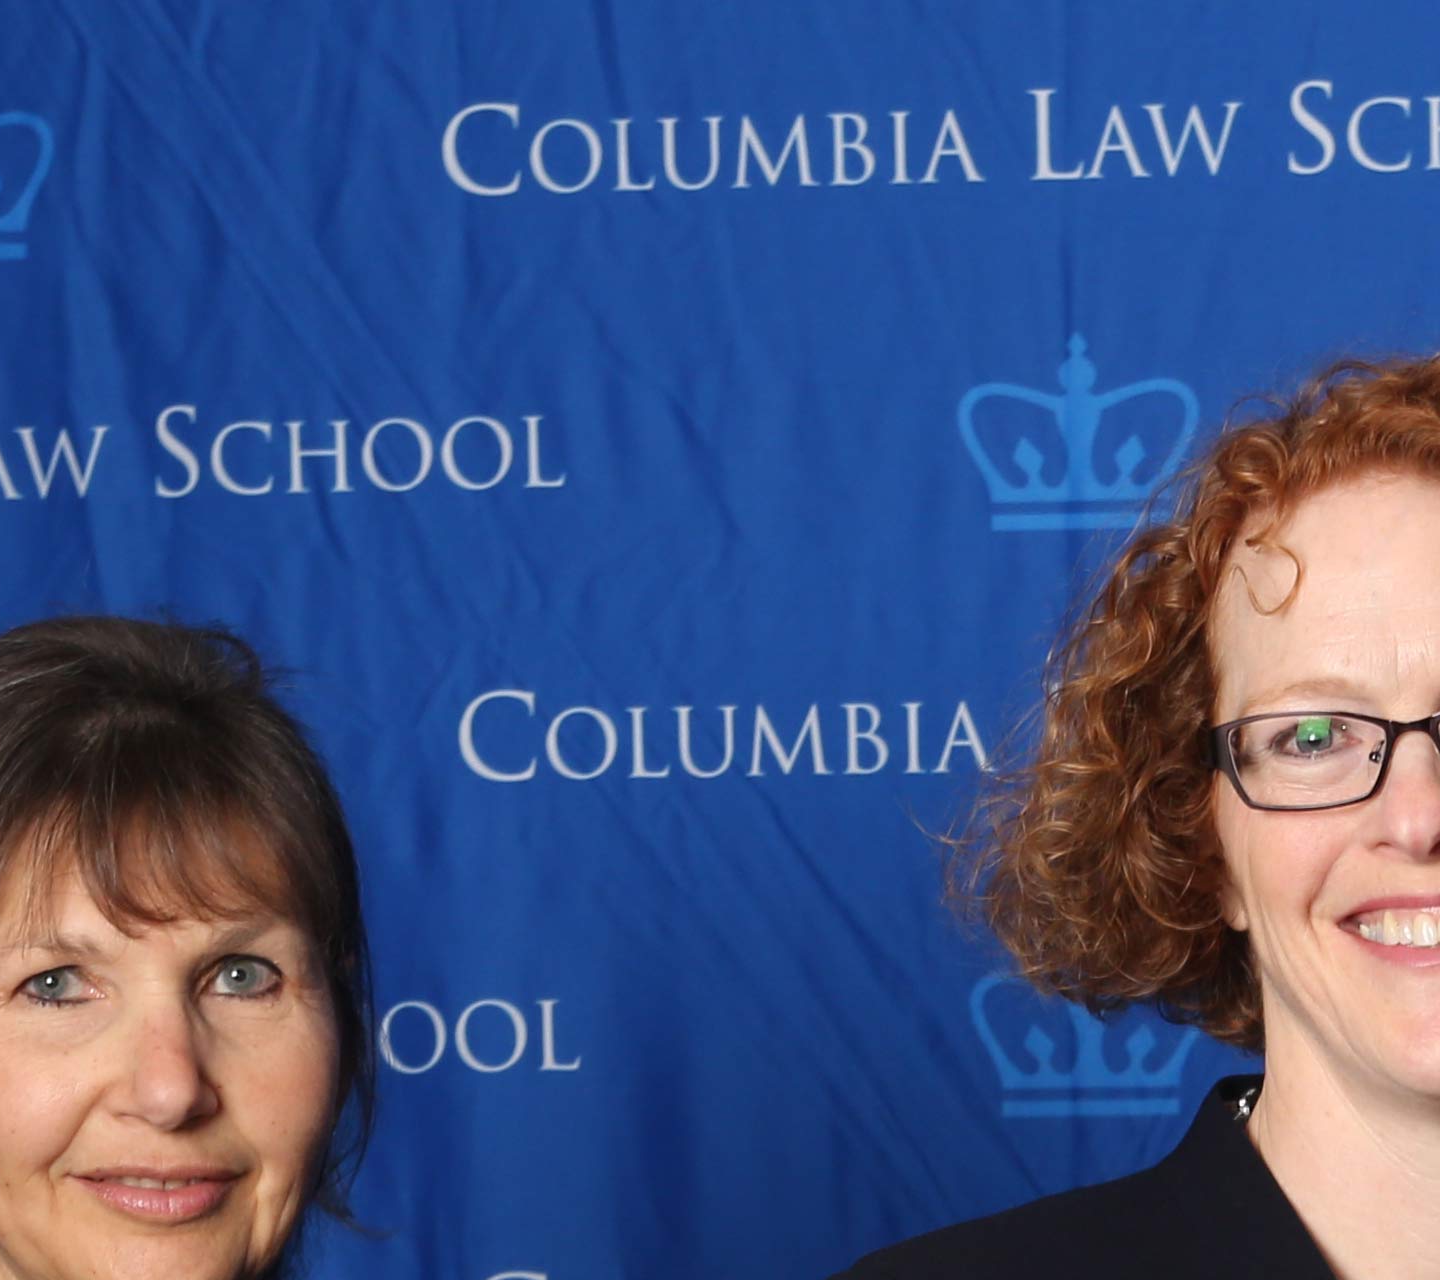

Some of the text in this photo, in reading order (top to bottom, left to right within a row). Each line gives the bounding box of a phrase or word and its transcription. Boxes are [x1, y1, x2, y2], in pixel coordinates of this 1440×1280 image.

[439, 100, 985, 197] COLUMBIA
[1026, 86, 1242, 181] LAW
[154, 402, 567, 500] SCHOOL
[457, 687, 990, 783] COLUMBIA
